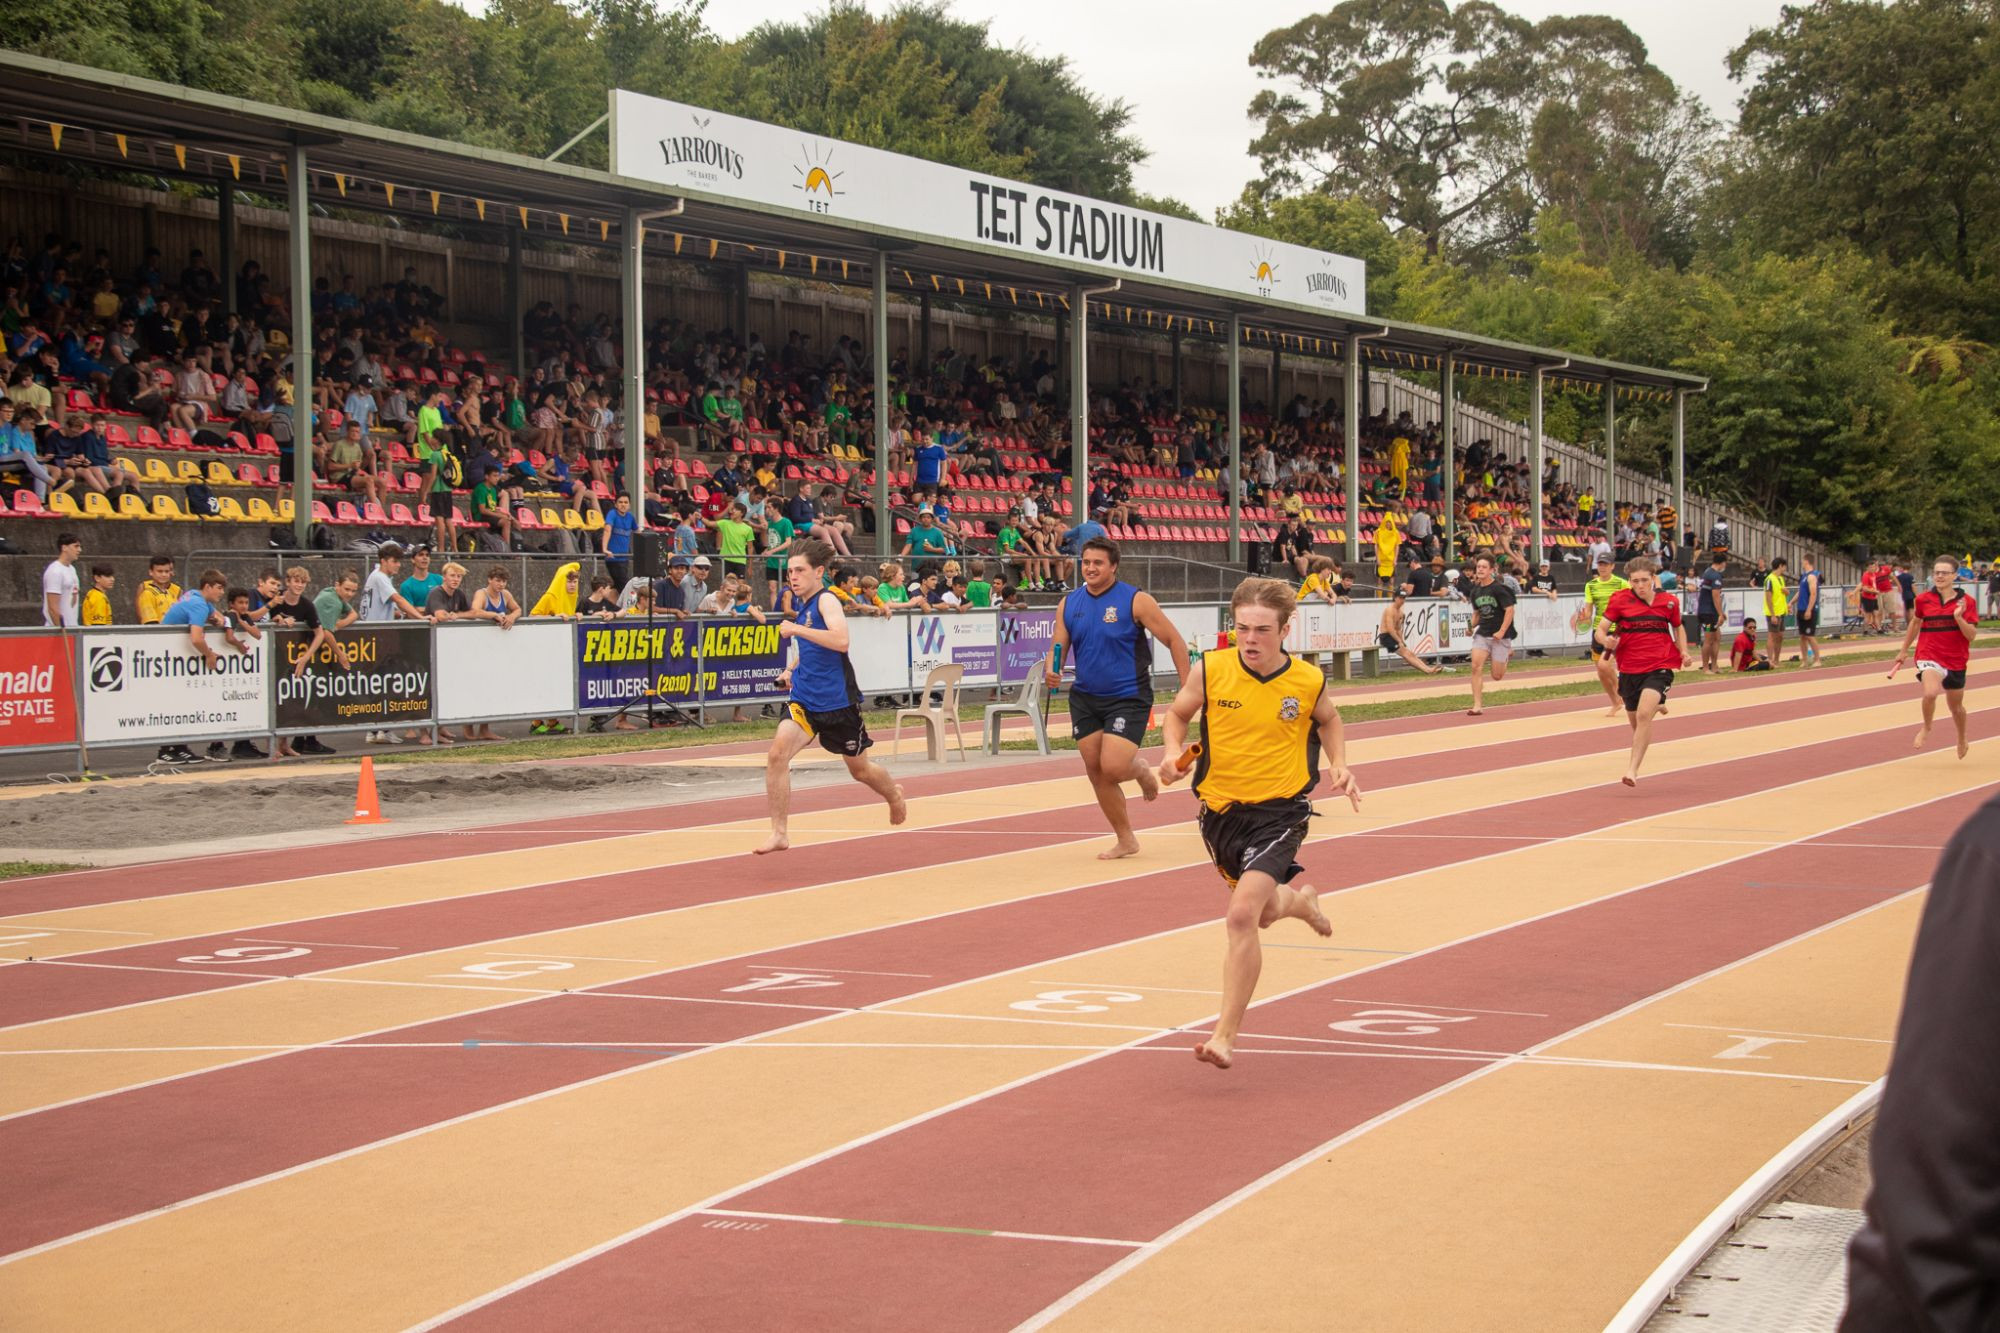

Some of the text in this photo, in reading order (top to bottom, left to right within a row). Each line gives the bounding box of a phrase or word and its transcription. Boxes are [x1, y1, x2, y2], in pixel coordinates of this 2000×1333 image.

[658, 136, 744, 180] YARROWS
[808, 199, 829, 214] TET
[970, 181, 1164, 273] T.E.T STADIUM
[1259, 287, 1271, 298] TET
[1306, 272, 1347, 301] YARROWS
[1417, 603, 1436, 636] OF
[583, 628, 667, 662] FABISH
[670, 627, 685, 658] &
[186, 679, 214, 688] REAL
[726, 670, 743, 680] KELLY
[752, 667, 784, 678] INGLEWOO
[222, 689, 260, 701] Collective
[278, 668, 428, 709] physiotherapy
[587, 677, 650, 700] BUILDERS
[657, 672, 691, 696] (2010)
[0, 698, 55, 718] STATE
[337, 699, 428, 717] Inglewood Stratford
[118, 710, 238, 728] www.fntaranaki.co.nz
